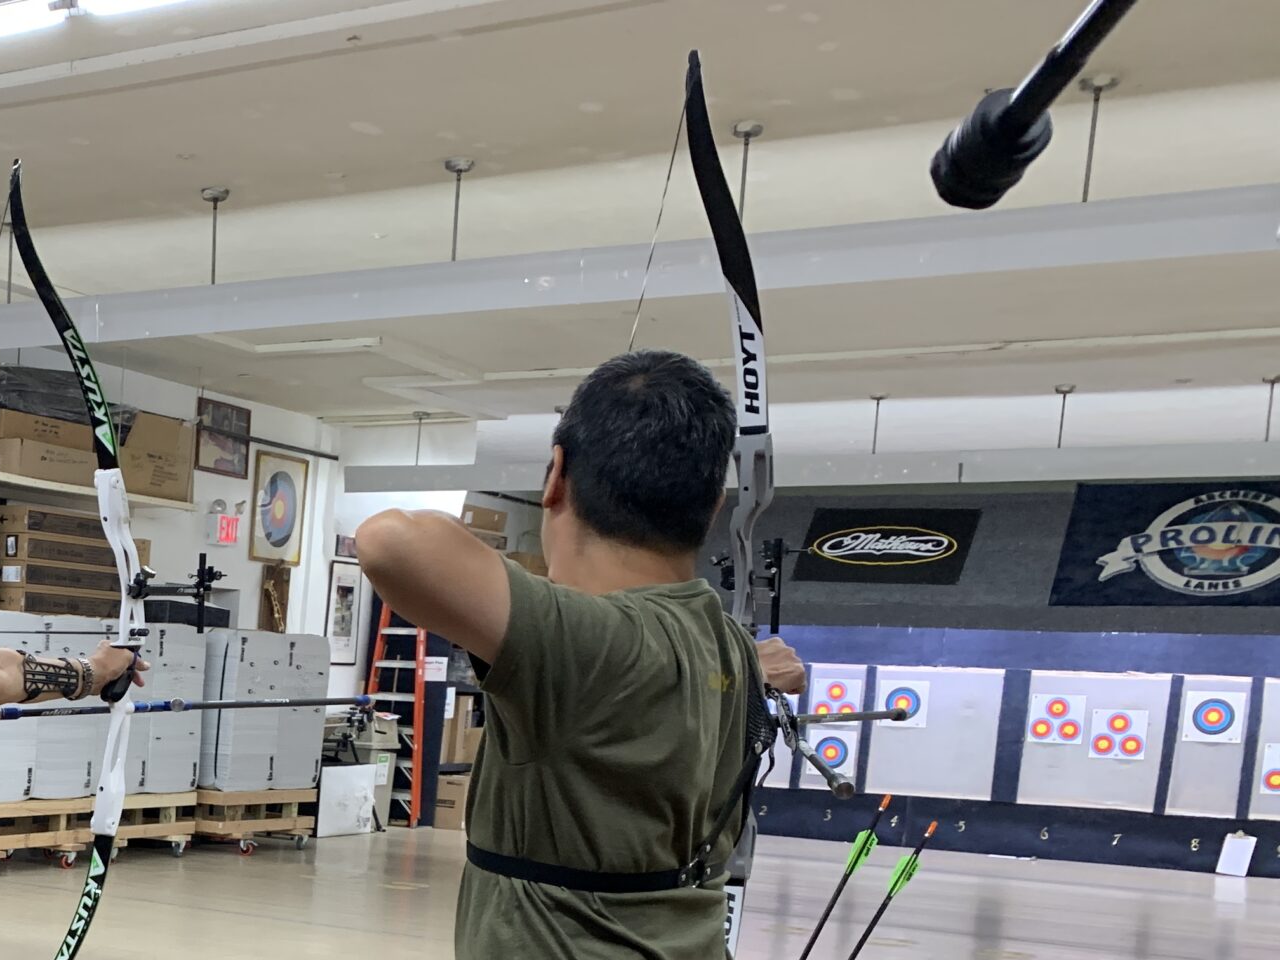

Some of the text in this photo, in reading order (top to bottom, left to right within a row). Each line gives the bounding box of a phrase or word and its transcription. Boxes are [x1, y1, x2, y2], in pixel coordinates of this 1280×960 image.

[739, 325, 761, 414] HOYT
[219, 515, 240, 544] EXIT
[1183, 579, 1242, 591] LANES
[758, 805, 768, 816] 2
[823, 810, 832, 822] 3
[890, 815, 899, 828] 4
[956, 821, 966, 832] 5
[1040, 827, 1049, 840] 6
[1112, 834, 1122, 846] 7
[1190, 838, 1200, 851] 8
